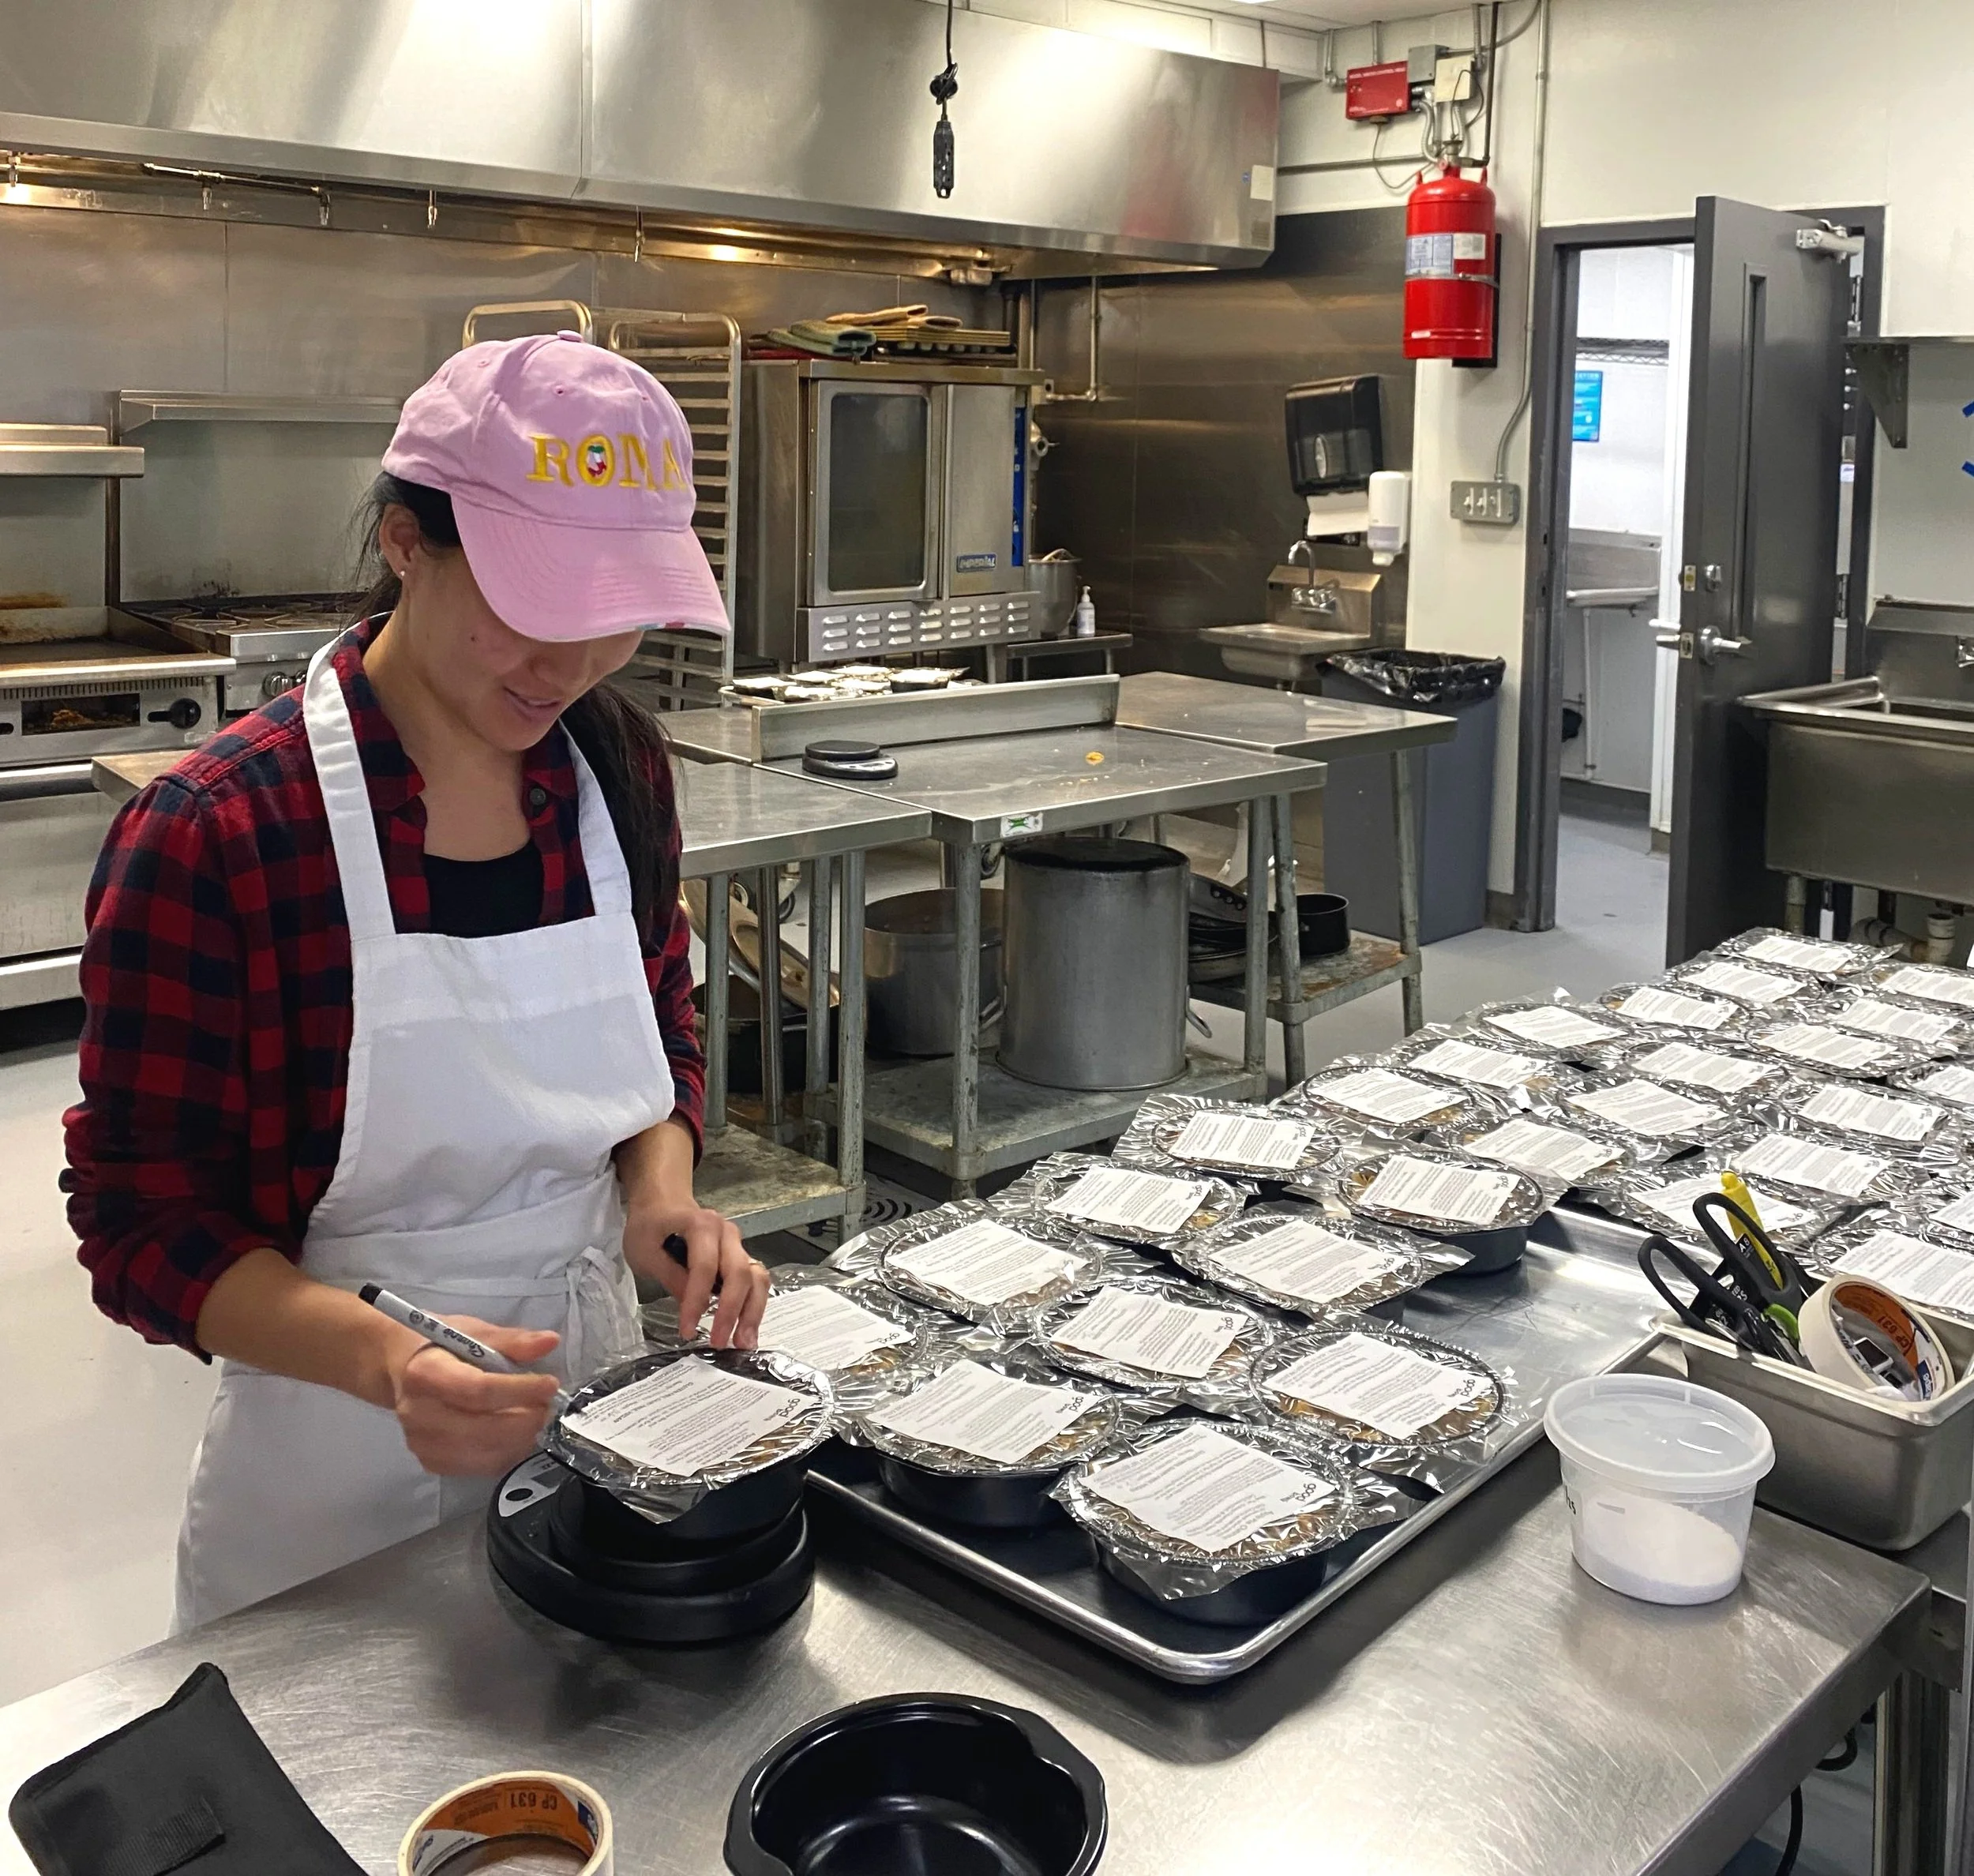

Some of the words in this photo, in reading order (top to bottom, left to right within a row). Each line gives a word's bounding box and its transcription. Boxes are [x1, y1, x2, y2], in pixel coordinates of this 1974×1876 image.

[525, 433, 689, 491] ROMA
[778, 1398, 801, 1418] good
[509, 1792, 538, 1808] 631
